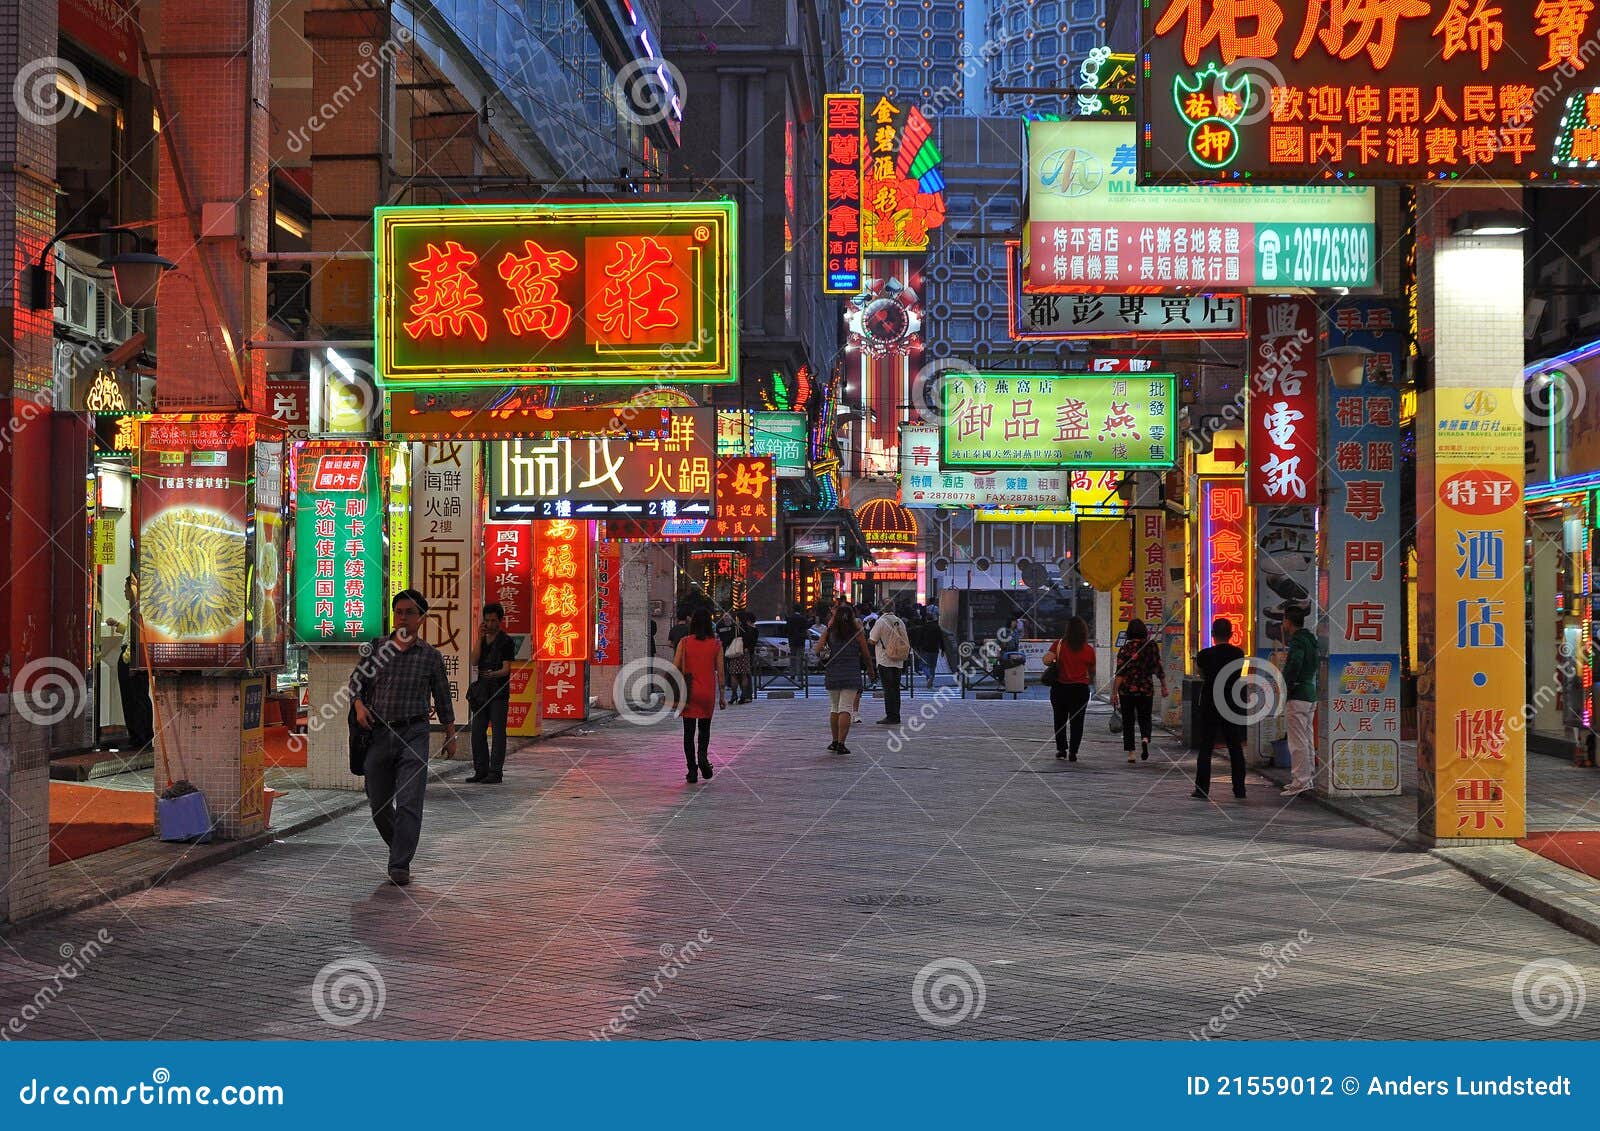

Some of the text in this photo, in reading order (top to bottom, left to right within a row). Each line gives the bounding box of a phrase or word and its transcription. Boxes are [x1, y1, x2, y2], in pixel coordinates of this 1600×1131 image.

[1186, 93, 1240, 118] 祐勝
[1270, 86, 1535, 123] 歡迎使用人民幣
[1197, 127, 1231, 161] 押
[1270, 126, 1537, 164] 國內卡消費特平
[829, 100, 859, 237] 至尊桑拿
[829, 241, 858, 255] 酒店
[1053, 228, 1240, 254] 特平酒店 代辦各地簽證
[829, 258, 858, 272] 6樓
[1053, 256, 1240, 281] 特價機票 長短線旅行團
[403, 237, 680, 342] 燕窩莊
[1335, 308, 1364, 472] 手相機
[1148, 381, 1166, 460] 批發零售
[320, 473, 359, 486] 國內卡
[424, 471, 462, 492] 海鮮
[645, 456, 711, 495] 火鍋
[910, 476, 933, 488] 特價
[942, 476, 965, 489] 酒店
[1447, 480, 1512, 506] 特平
[424, 497, 462, 517] 火鍋
[430, 520, 452, 534] 2樓
[314, 498, 335, 637] 欢迎使用国内卡
[344, 498, 365, 637] 刷卡手续费特平
[1344, 481, 1386, 642] 專門店
[1455, 529, 1505, 829] 酒店 機票
[1333, 698, 1397, 713] 欢迎使用
[1333, 717, 1397, 732] 人民币
